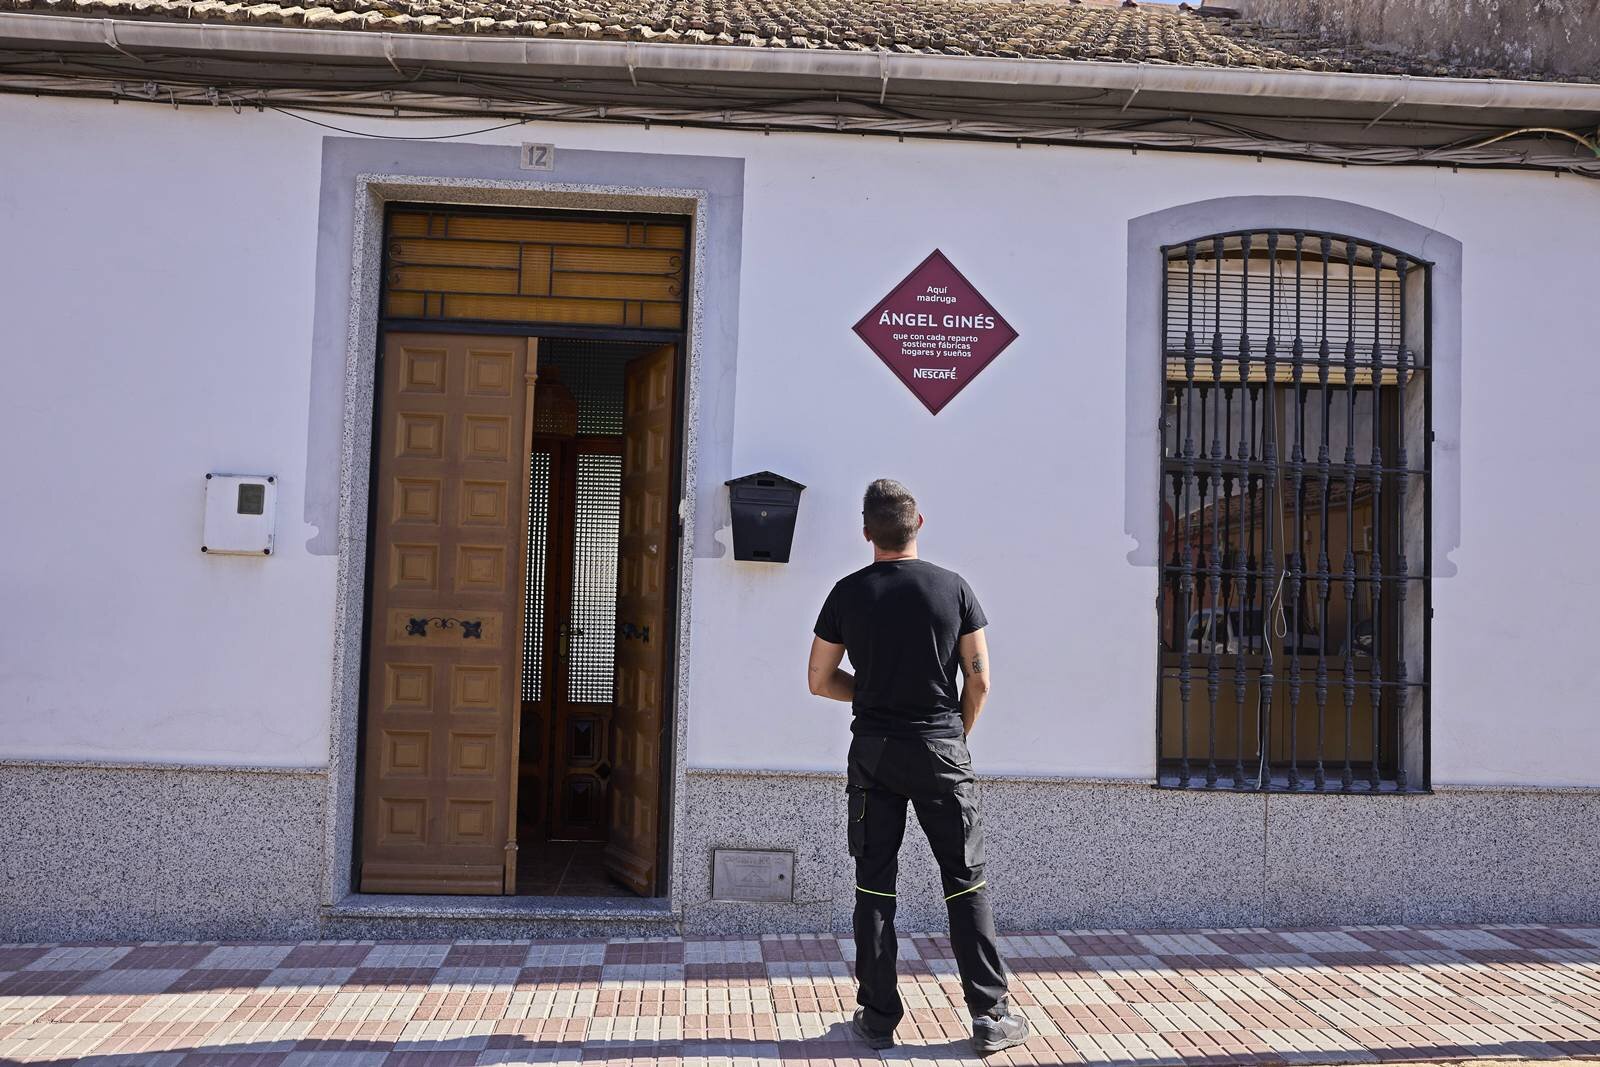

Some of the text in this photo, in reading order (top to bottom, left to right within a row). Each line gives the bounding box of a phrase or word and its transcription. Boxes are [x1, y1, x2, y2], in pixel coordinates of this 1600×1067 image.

[528, 146, 547, 166] 12
[926, 286, 948, 294] Aquí
[917, 295, 957, 304] madruga
[879, 310, 995, 329] ÁNGEL GINÉS
[893, 333, 908, 341] que
[947, 335, 978, 343] reparto
[938, 341, 971, 350] fábricas
[901, 348, 934, 357] hogares
[943, 349, 971, 357] sueños
[913, 367, 957, 379] NESCAFÉ
